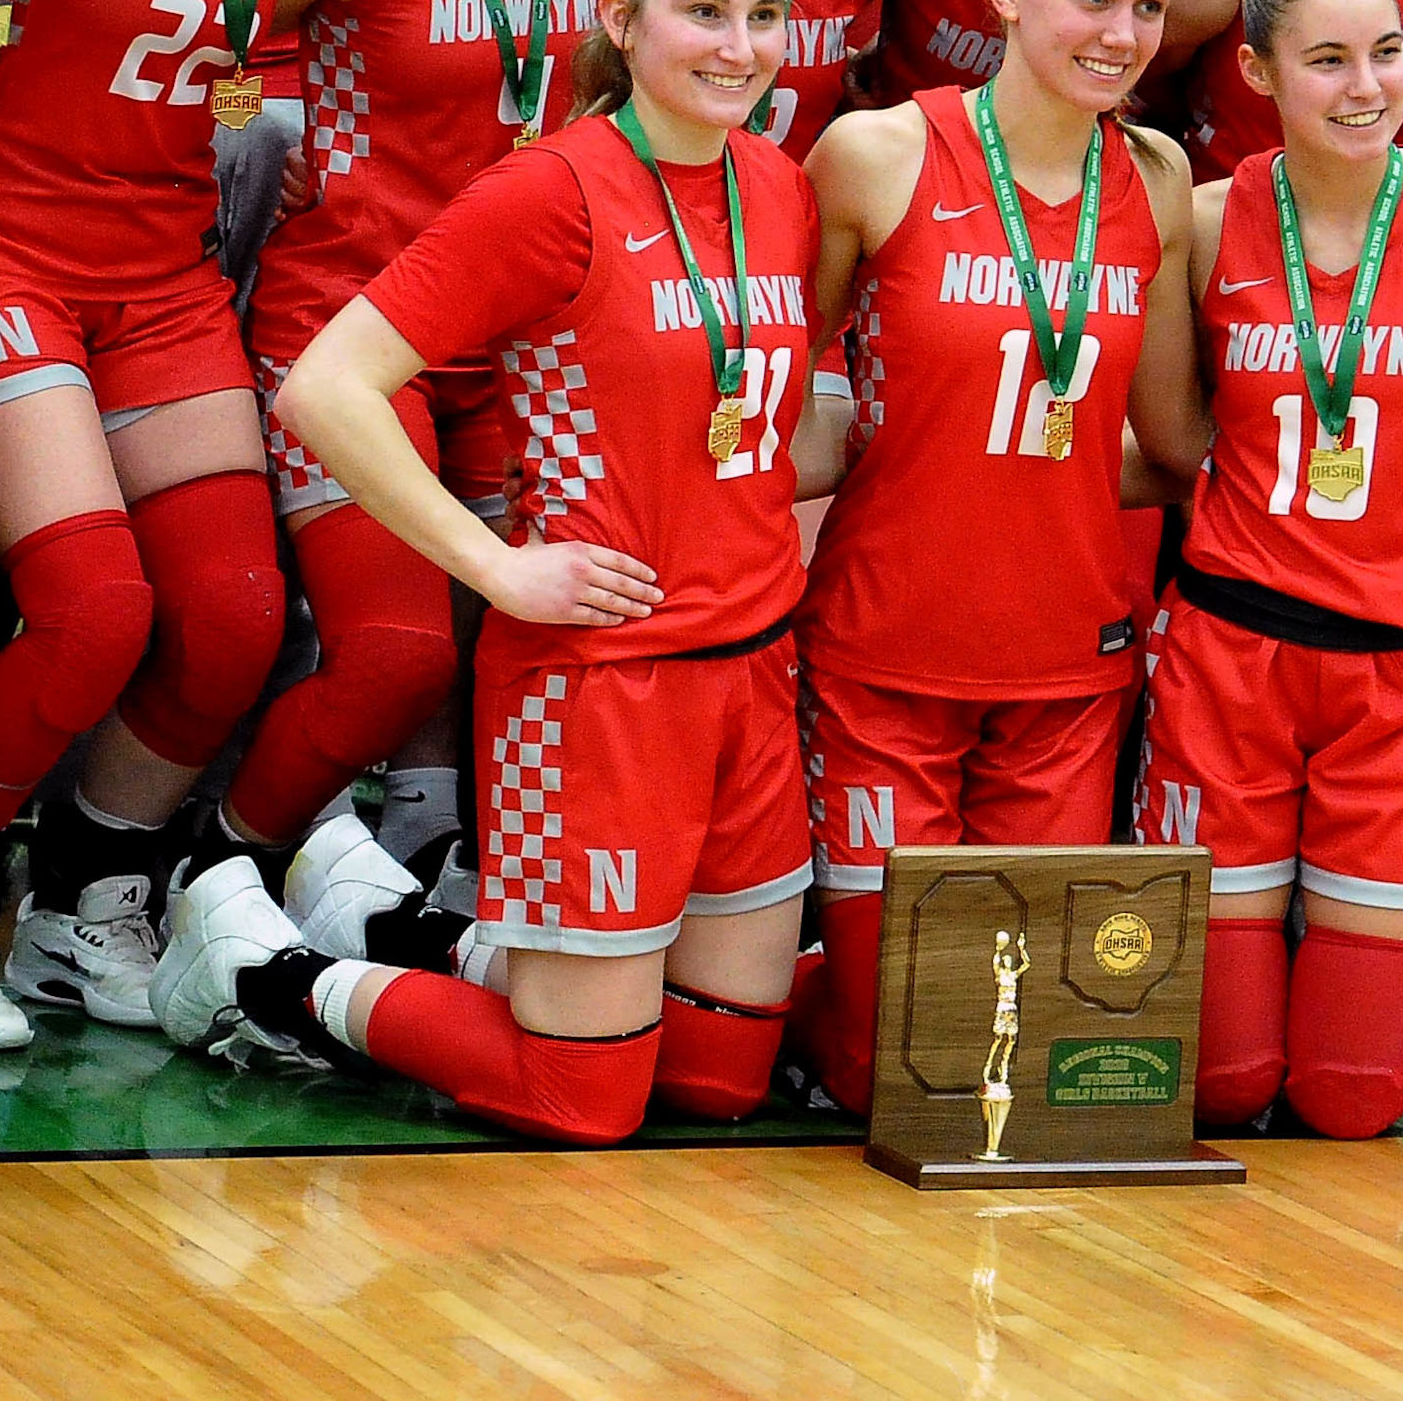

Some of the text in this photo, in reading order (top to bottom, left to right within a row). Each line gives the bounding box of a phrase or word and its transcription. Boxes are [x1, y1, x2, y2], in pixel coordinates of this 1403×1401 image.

[214, 95, 260, 109] OHSAA
[716, 347, 792, 480] 21
[985, 329, 1101, 457] 12
[1311, 464, 1361, 480] OHSAA
[848, 786, 895, 848] N
[1160, 779, 1200, 845] N
[586, 847, 638, 913] N
[1105, 938, 1141, 950] OHSAA
